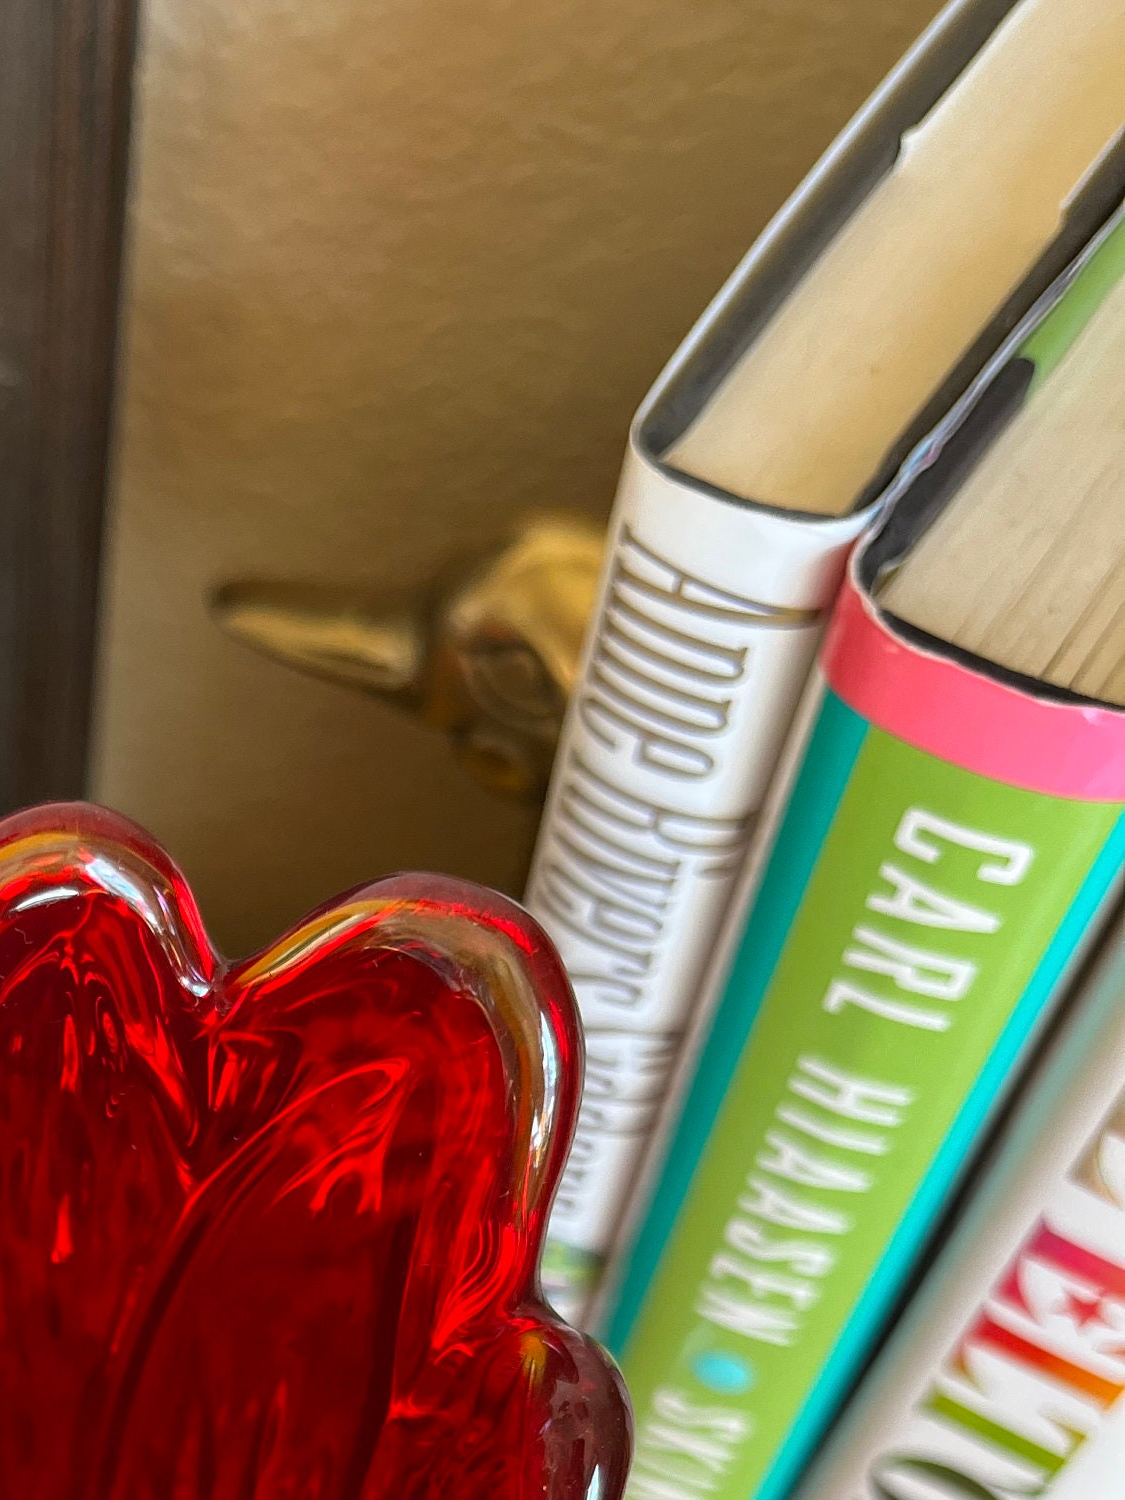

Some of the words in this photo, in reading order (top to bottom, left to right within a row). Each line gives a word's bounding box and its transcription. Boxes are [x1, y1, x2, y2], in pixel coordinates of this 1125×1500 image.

[577, 522, 827, 784] Anne
[537, 757, 761, 1014] Rivers
[823, 805, 1035, 1034] CARL
[693, 1051, 916, 1348] HIAASEN
